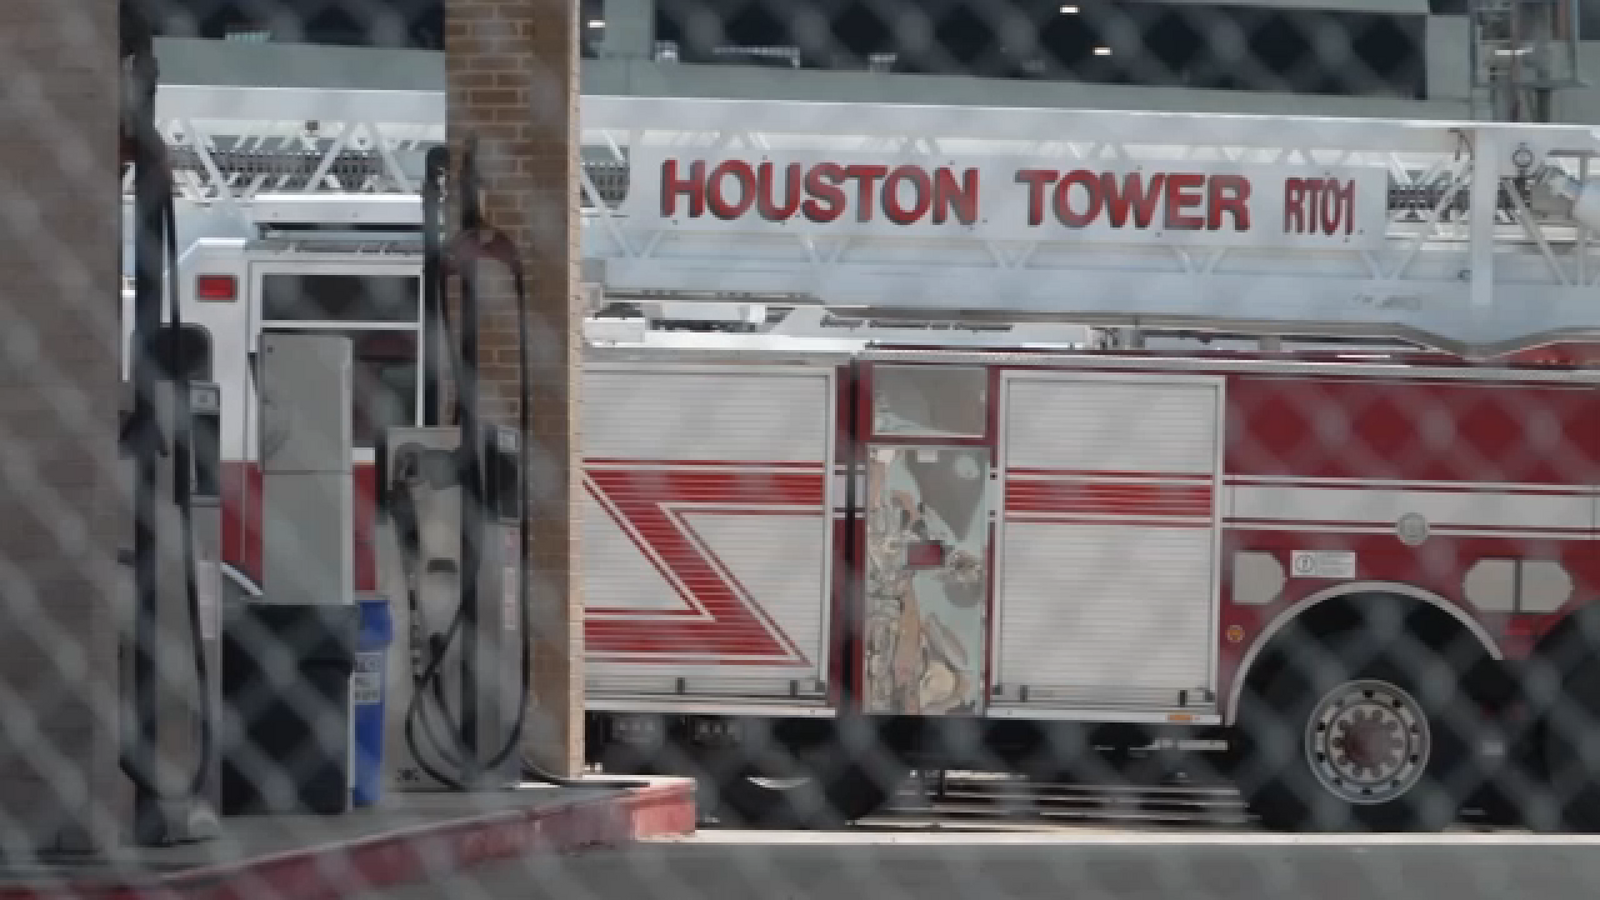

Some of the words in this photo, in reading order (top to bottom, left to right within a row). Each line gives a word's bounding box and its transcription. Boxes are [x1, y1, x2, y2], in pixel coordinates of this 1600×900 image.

[660, 158, 979, 225] HOUSTON
[1015, 169, 1251, 232] TOWER
[1283, 177, 1356, 235] RT01
